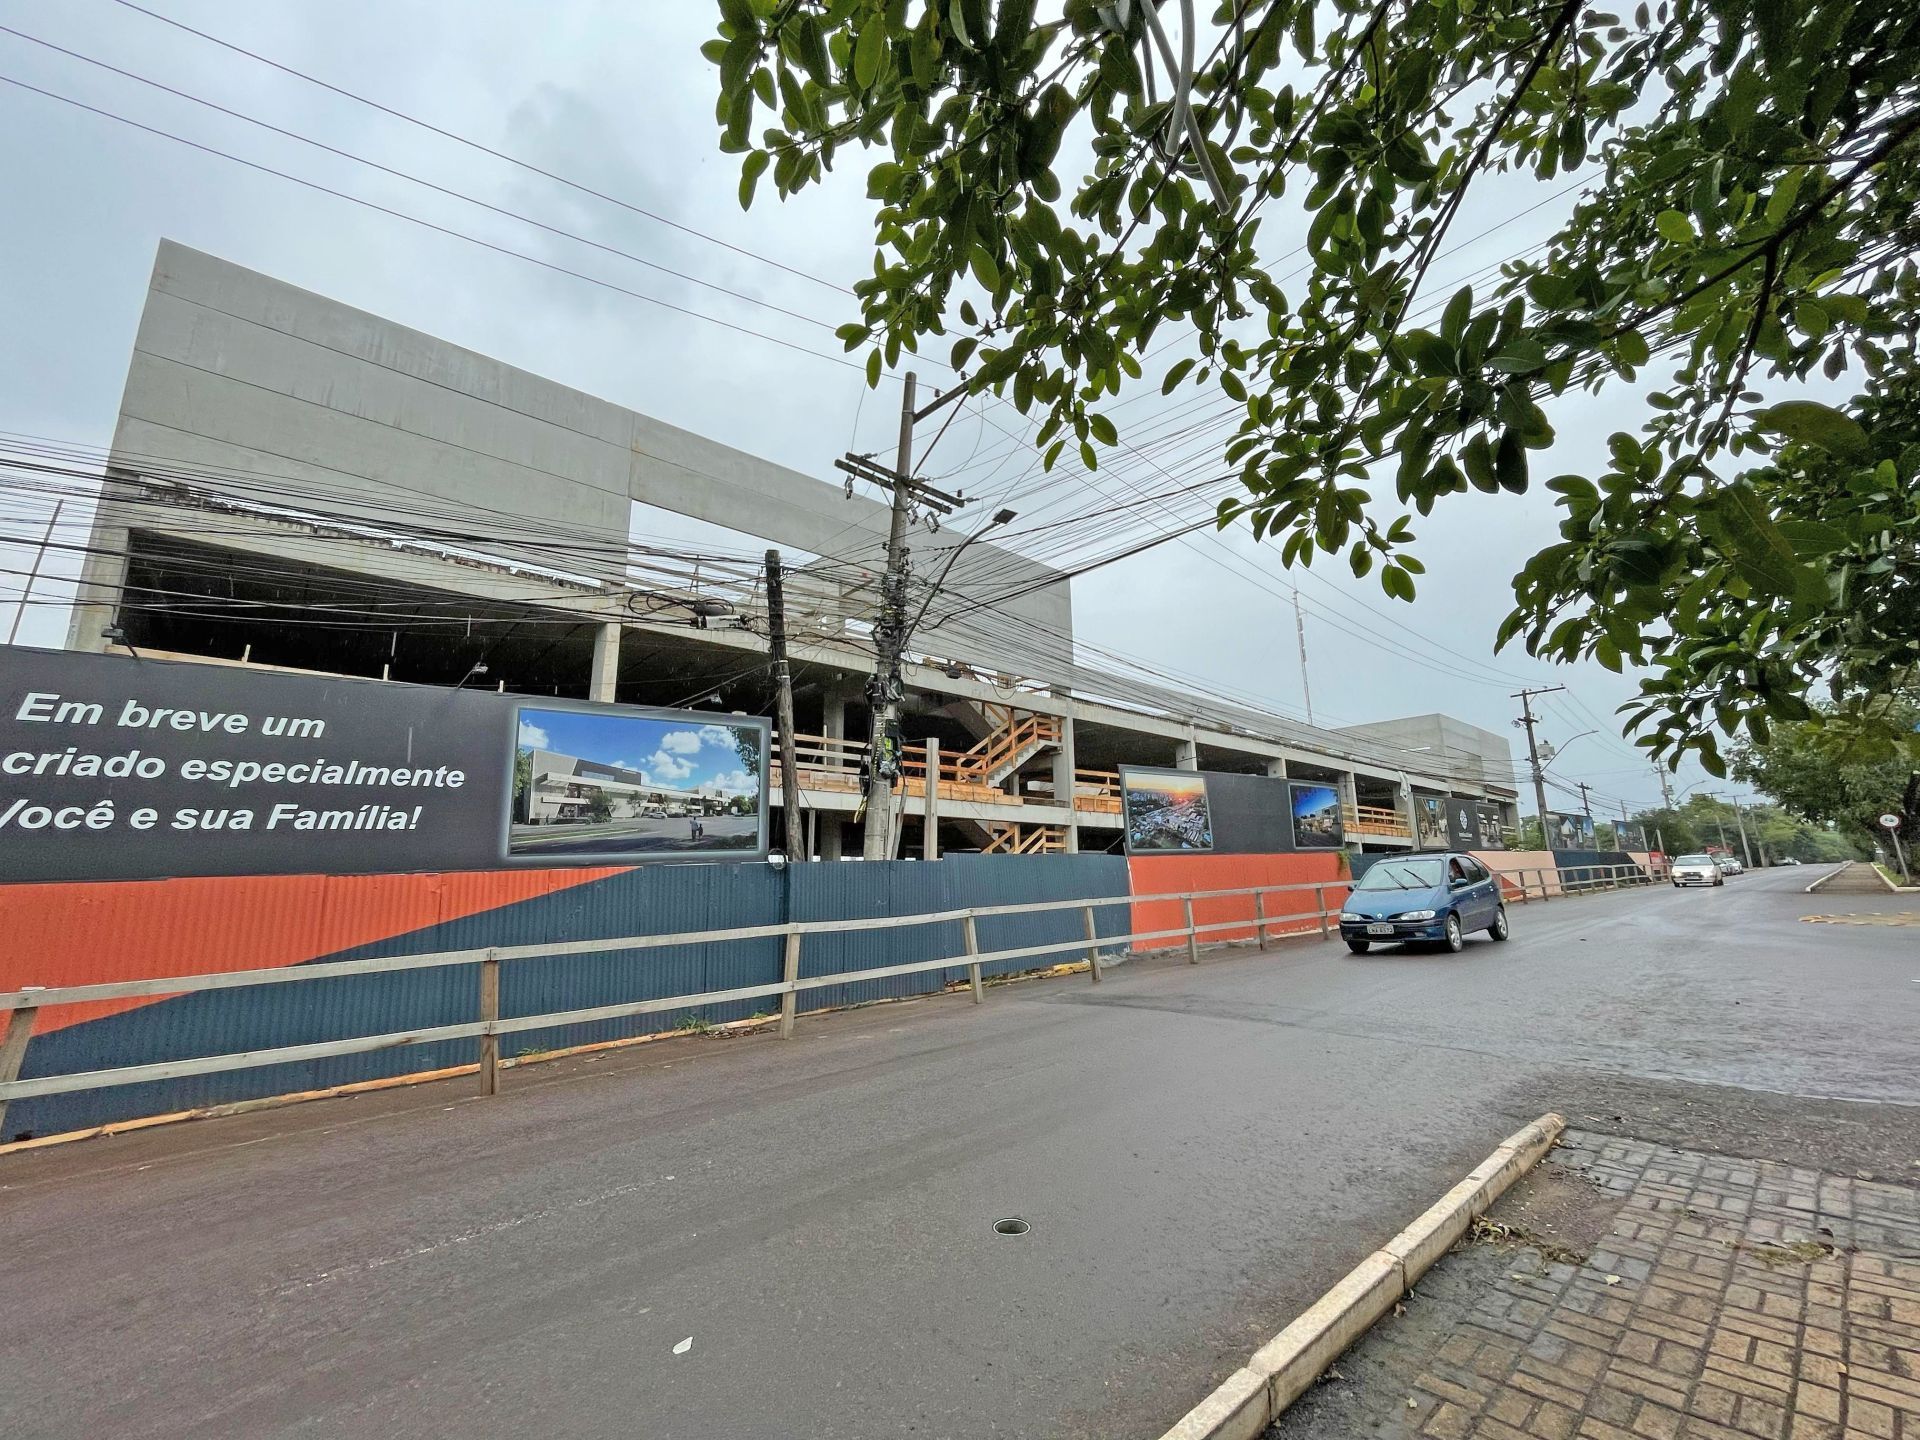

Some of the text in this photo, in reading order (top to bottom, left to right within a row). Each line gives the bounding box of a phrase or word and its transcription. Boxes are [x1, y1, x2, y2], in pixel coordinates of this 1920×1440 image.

[15, 692, 326, 738] Em breve um
[1, 747, 465, 788] criado especialmente
[129, 807, 159, 830] e
[170, 808, 254, 830] sua
[265, 803, 423, 830] Família!
